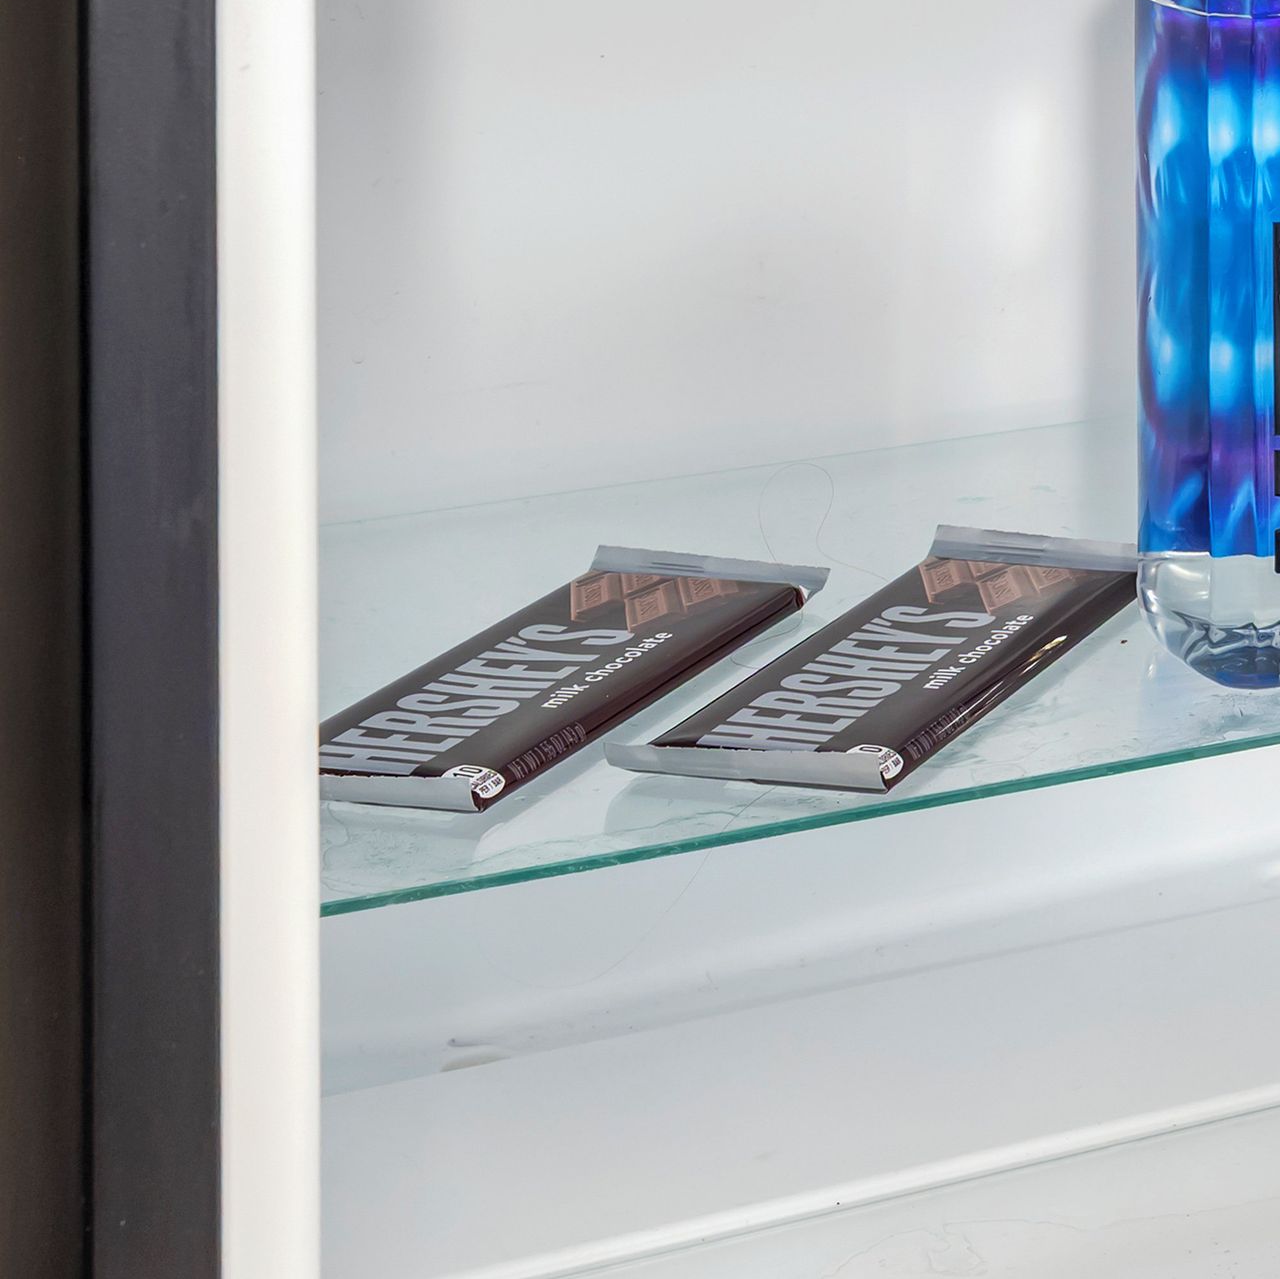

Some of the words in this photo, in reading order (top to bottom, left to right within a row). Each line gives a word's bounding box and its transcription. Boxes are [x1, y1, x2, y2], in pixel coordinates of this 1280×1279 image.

[319, 623, 635, 776] HERSHEY'S
[540, 682, 590, 709] milk
[585, 631, 673, 684] chocolate
[696, 605, 996, 752] HERSHEY'S
[923, 664, 966, 690] milk
[959, 614, 1034, 664] chocolate
